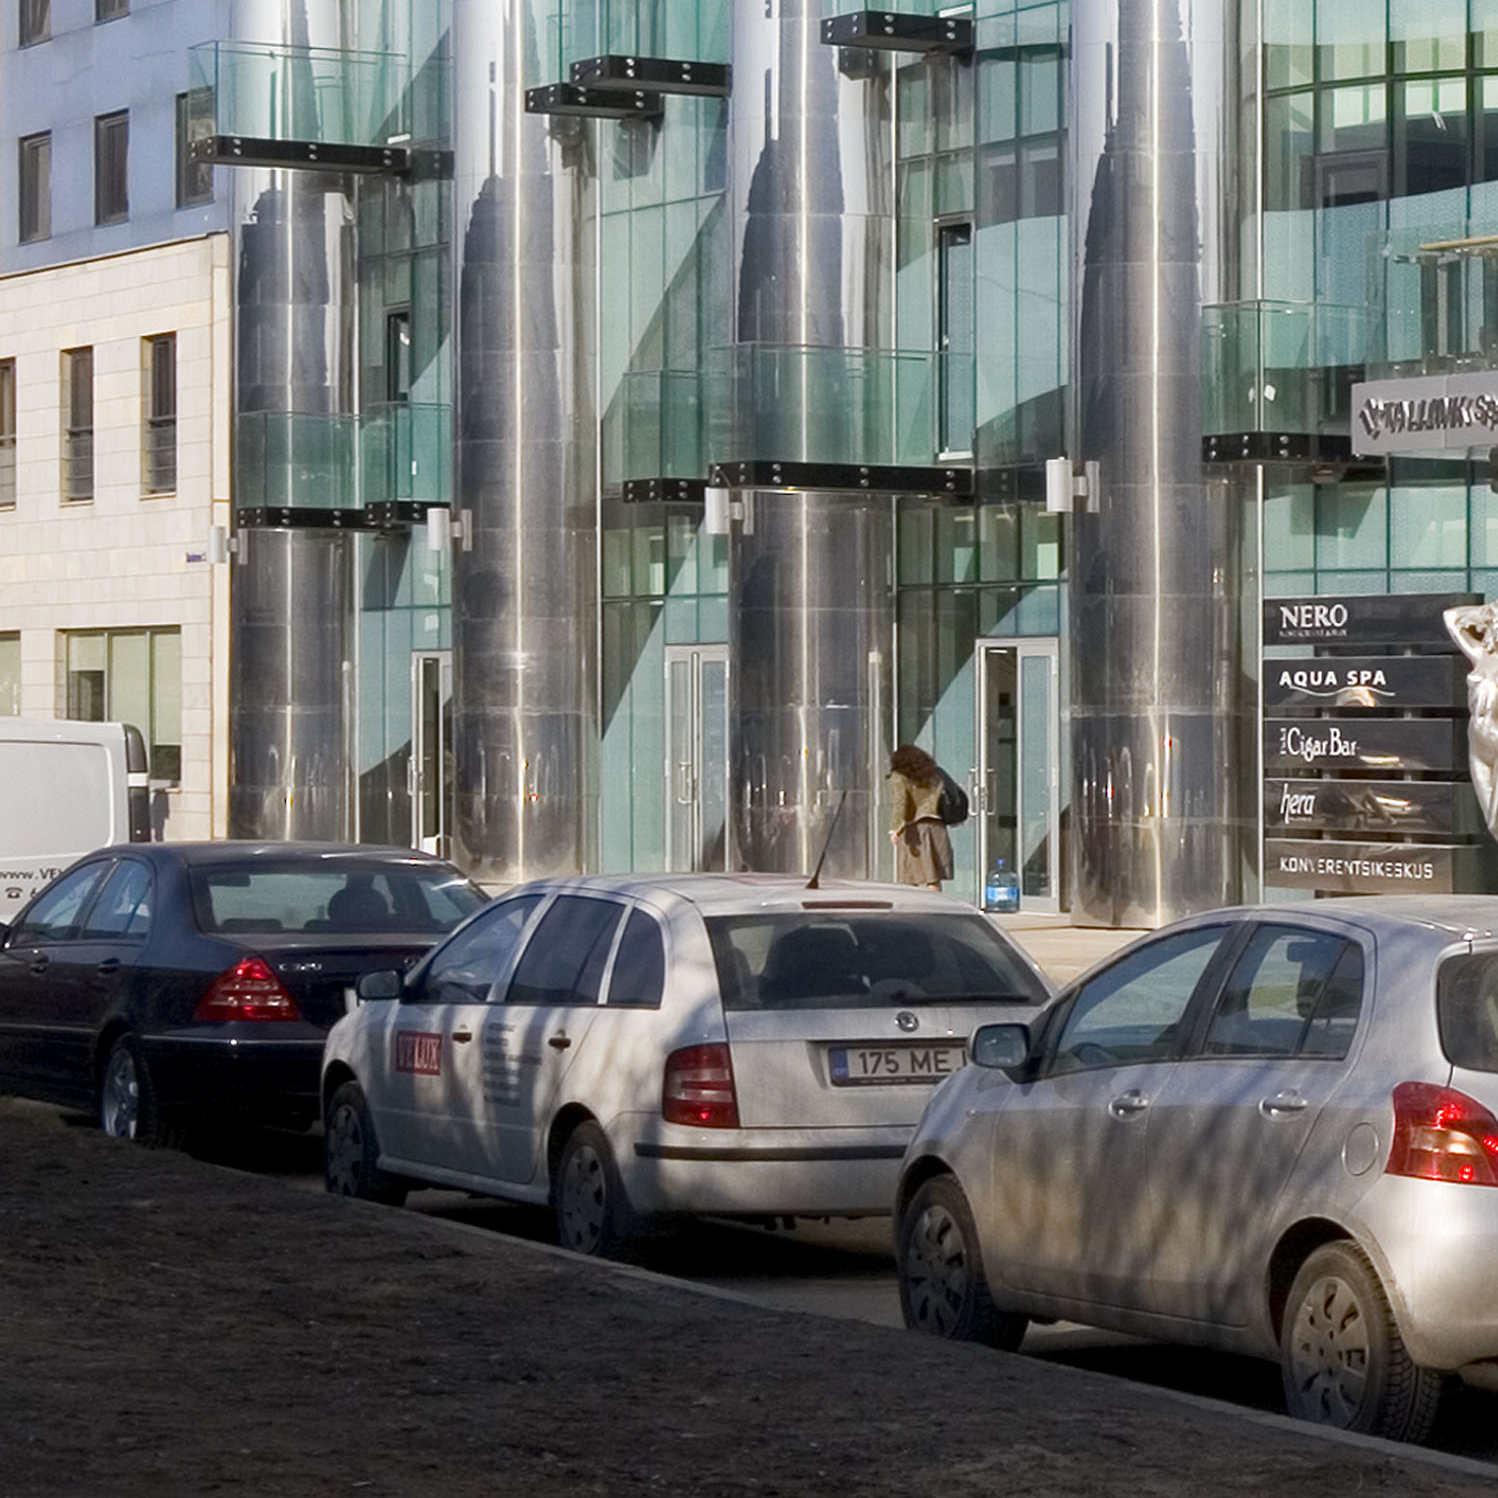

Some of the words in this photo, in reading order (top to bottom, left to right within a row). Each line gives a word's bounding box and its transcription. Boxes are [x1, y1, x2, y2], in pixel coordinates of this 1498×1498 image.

[1383, 396, 1471, 433] TALLINK
[1280, 603, 1349, 629] NERO
[1279, 670, 1338, 688] AQUA
[1346, 669, 1387, 687] SPA
[1287, 726, 1328, 762] Cigar
[1328, 727, 1358, 757] Bar
[1280, 782, 1316, 825] hera
[1279, 856, 1434, 880] KONVERENTSIKESKUS
[858, 1050, 900, 1075] 175
